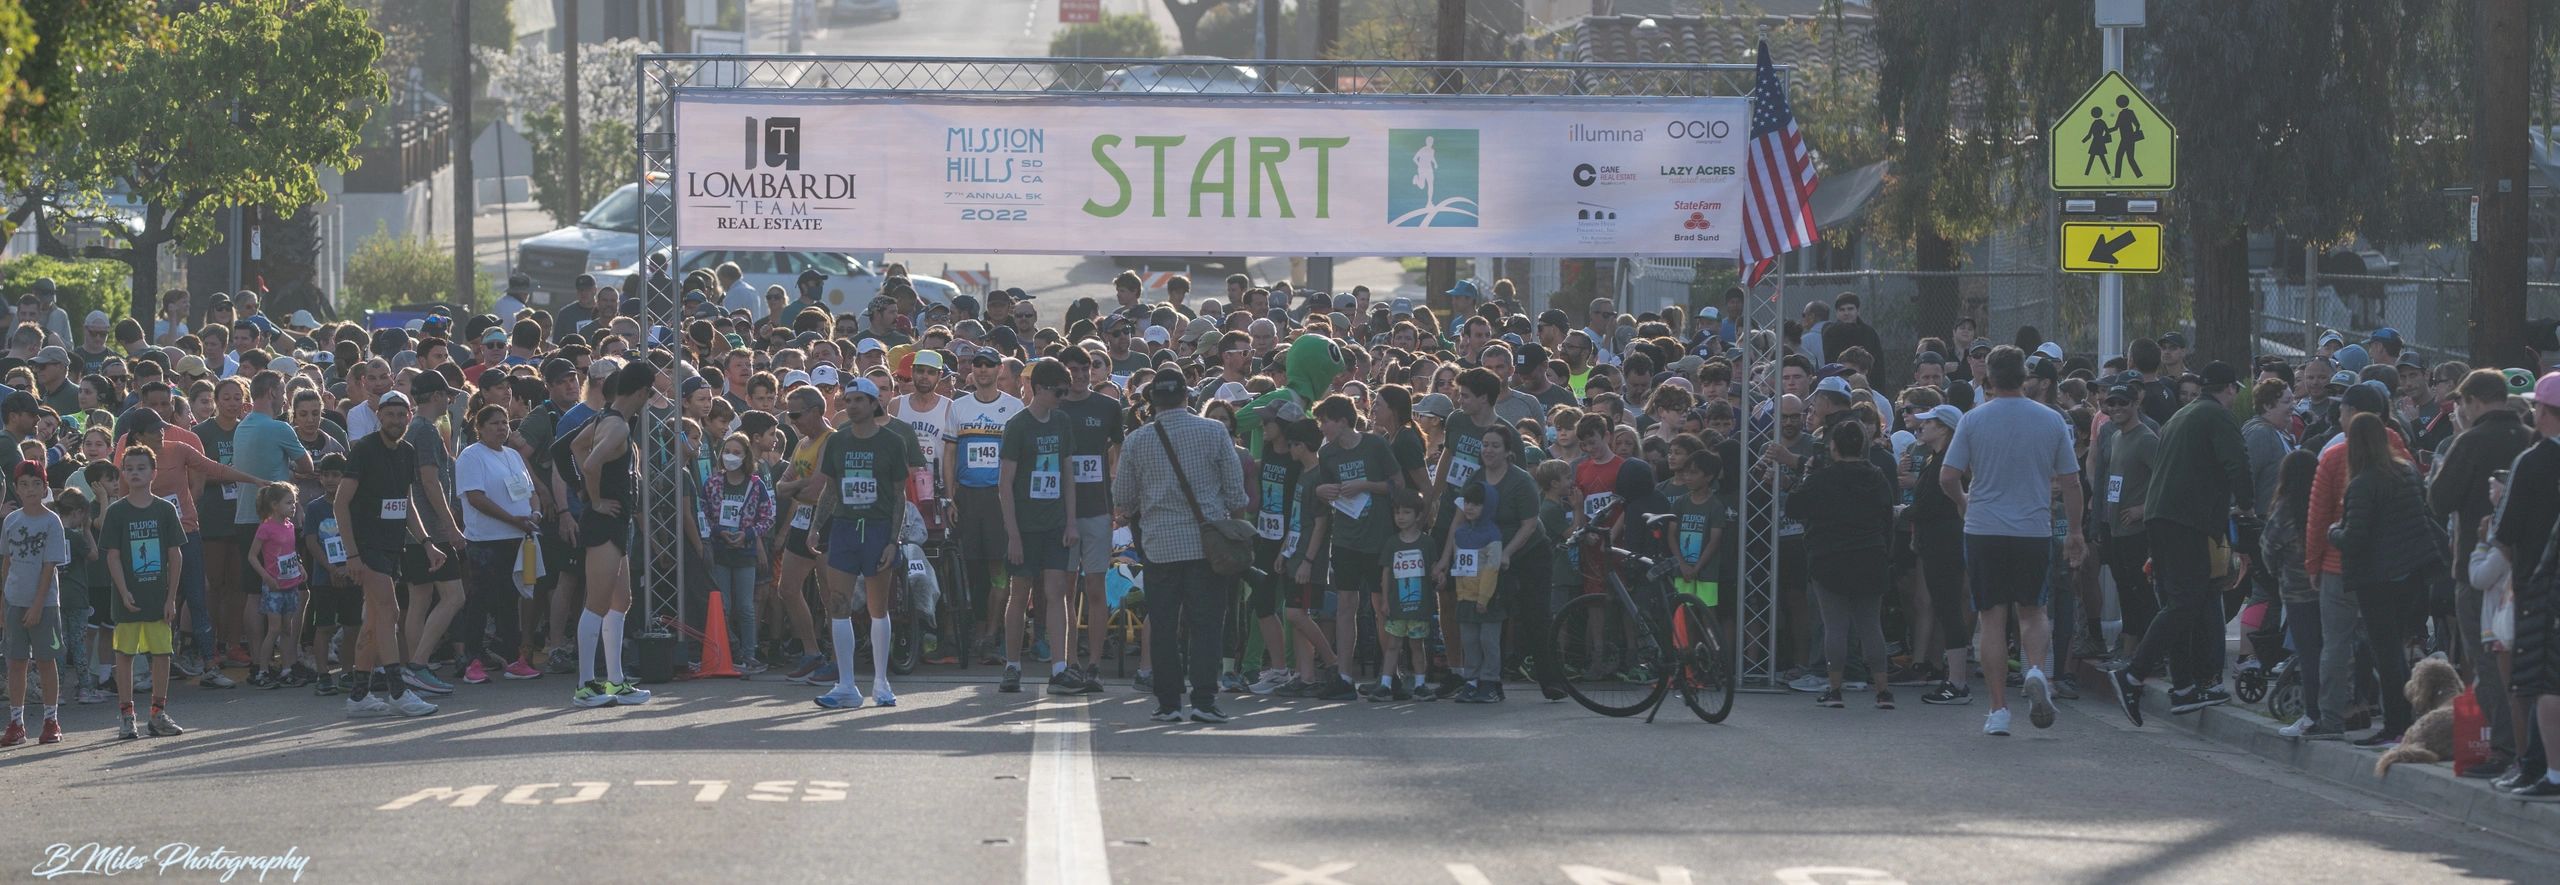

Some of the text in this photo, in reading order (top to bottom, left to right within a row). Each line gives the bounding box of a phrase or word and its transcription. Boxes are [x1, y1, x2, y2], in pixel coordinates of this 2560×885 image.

[1569, 124, 1644, 142] illumina
[1668, 120, 1729, 139] OCIO
[945, 127, 1044, 153] MISSION
[946, 157, 1014, 183] HILLS
[1082, 134, 1351, 218] START
[1660, 165, 1736, 175] LAZY ACRES
[688, 172, 856, 199] LOMBARDI
[1021, 175, 1043, 183] CA
[736, 200, 808, 215] TEAM
[961, 208, 1028, 221] 2022
[717, 217, 823, 231] REAL ESTATE
[912, 421, 940, 437] ORIDA
[978, 447, 996, 458] 143
[1083, 460, 1097, 472] 82
[853, 481, 875, 493] 495
[1045, 476, 1056, 489] 78
[384, 501, 406, 512] 4619
[1267, 519, 1279, 530] 83
[1394, 559, 1425, 570] 4630
[1459, 553, 1473, 566] 86
